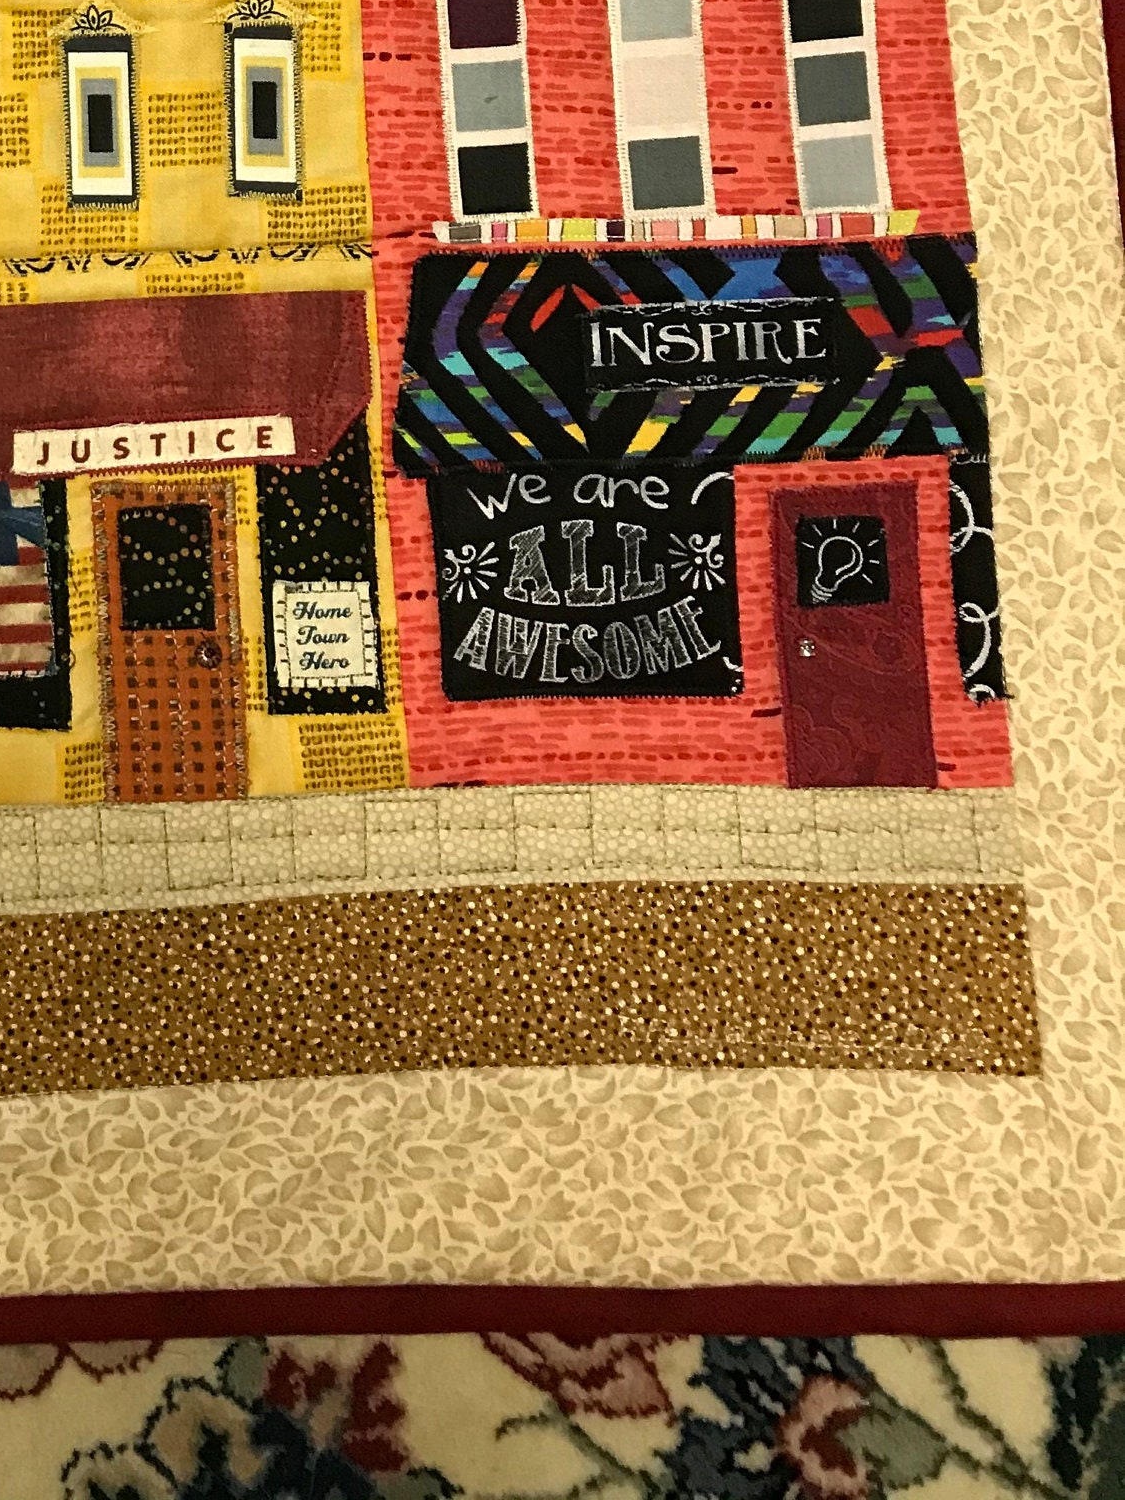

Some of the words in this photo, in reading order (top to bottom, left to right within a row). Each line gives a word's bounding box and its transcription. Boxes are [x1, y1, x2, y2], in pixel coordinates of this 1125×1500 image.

[590, 318, 827, 367] INSPIRE
[36, 425, 274, 466] JUSTICE
[574, 473, 670, 510] are
[503, 518, 667, 608] ALL
[292, 601, 353, 620] Home
[296, 625, 350, 645] Town
[453, 595, 722, 684] AWESOME
[299, 651, 351, 671] Hero
